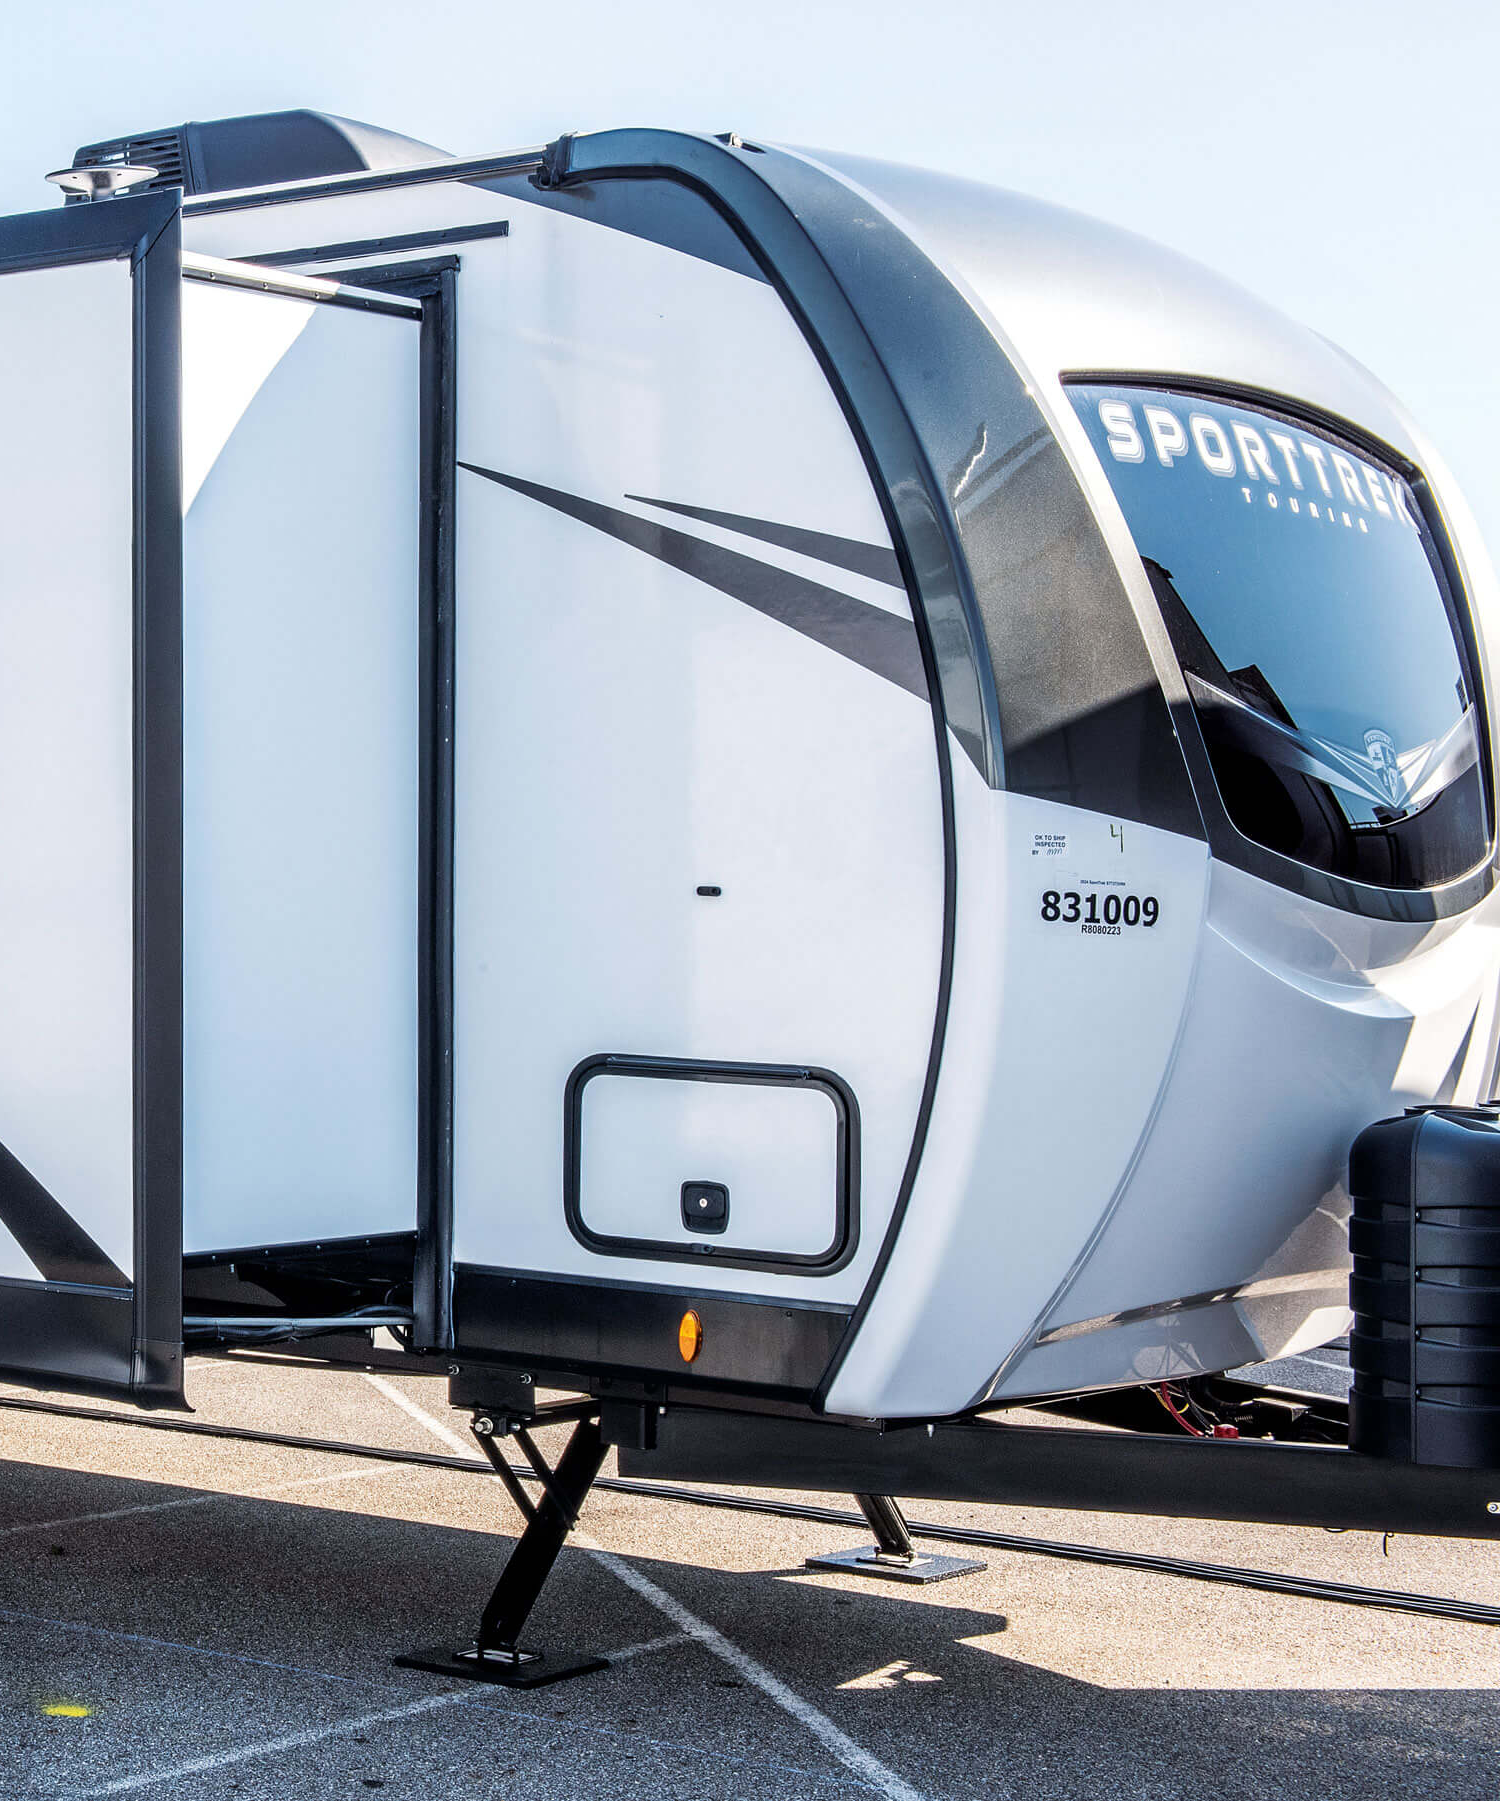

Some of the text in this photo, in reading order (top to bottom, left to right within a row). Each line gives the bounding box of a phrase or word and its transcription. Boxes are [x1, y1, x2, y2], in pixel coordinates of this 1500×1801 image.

[1098, 398, 1415, 530] SPORTTREK
[1241, 487, 1369, 533] TOURING
[1109, 823, 1124, 853] 4
[1041, 890, 1160, 928] 831009
[1081, 924, 1122, 936] R8080223
